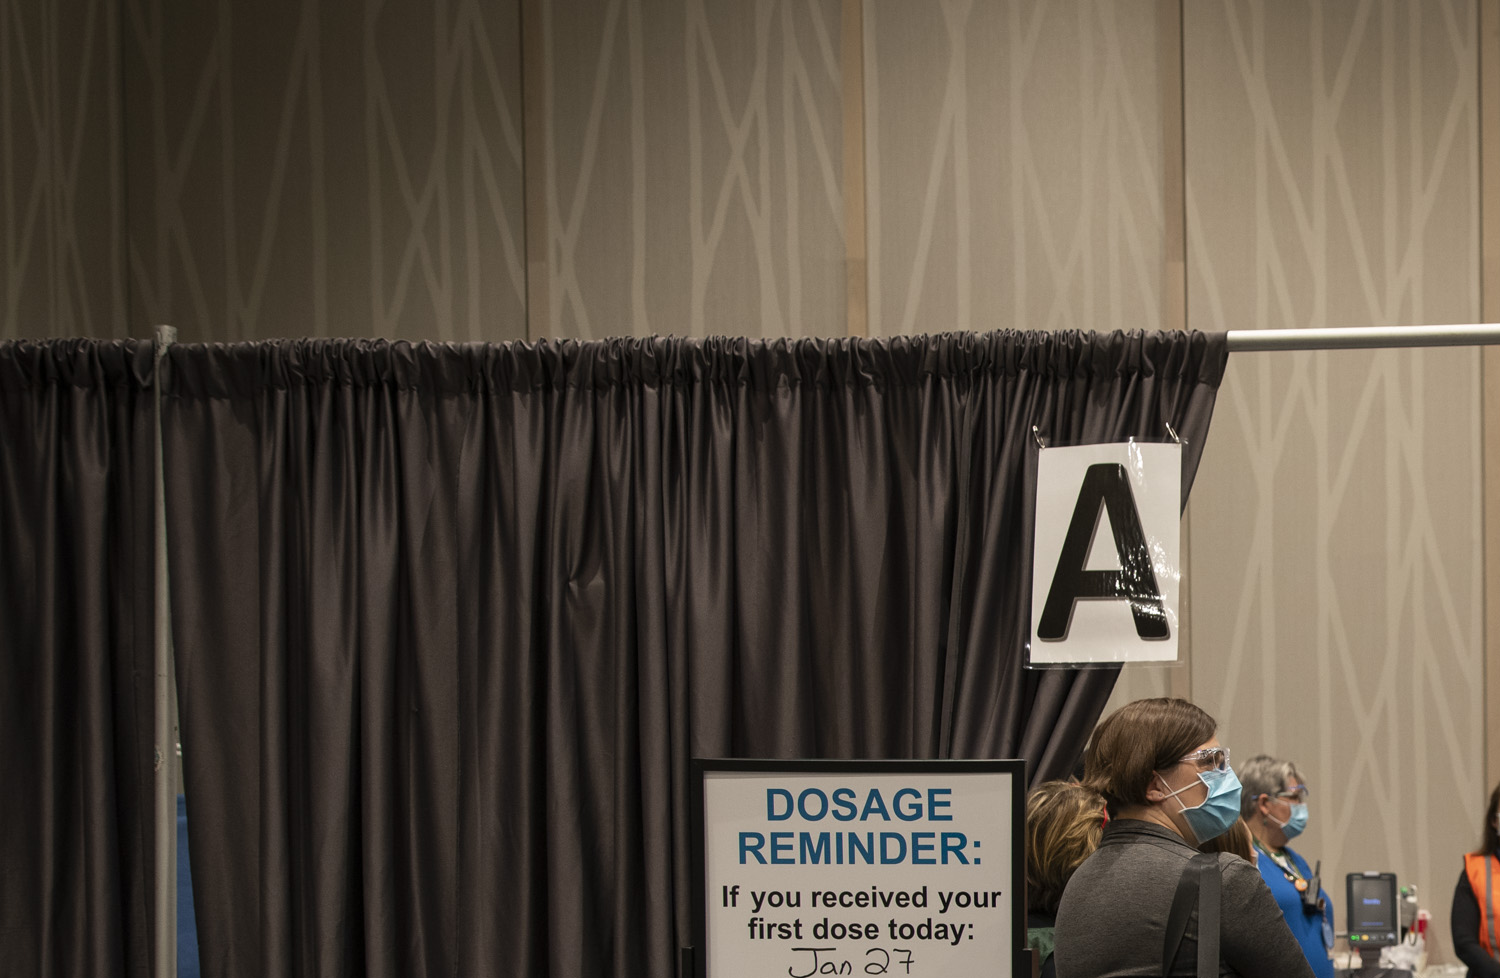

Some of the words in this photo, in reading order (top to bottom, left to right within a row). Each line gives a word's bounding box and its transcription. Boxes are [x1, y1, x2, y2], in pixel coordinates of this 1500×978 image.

[1037, 463, 1169, 640] A
[766, 787, 953, 822] DOSAGE
[738, 831, 981, 865] REMINDER:
[722, 885, 740, 908] If
[751, 890, 801, 913] you
[811, 885, 928, 908] received
[937, 890, 1001, 914] your
[747, 917, 803, 940] first
[812, 917, 879, 940] dose
[888, 917, 974, 946] today:
[788, 947, 852, 978] Jan
[864, 948, 915, 975] 27
